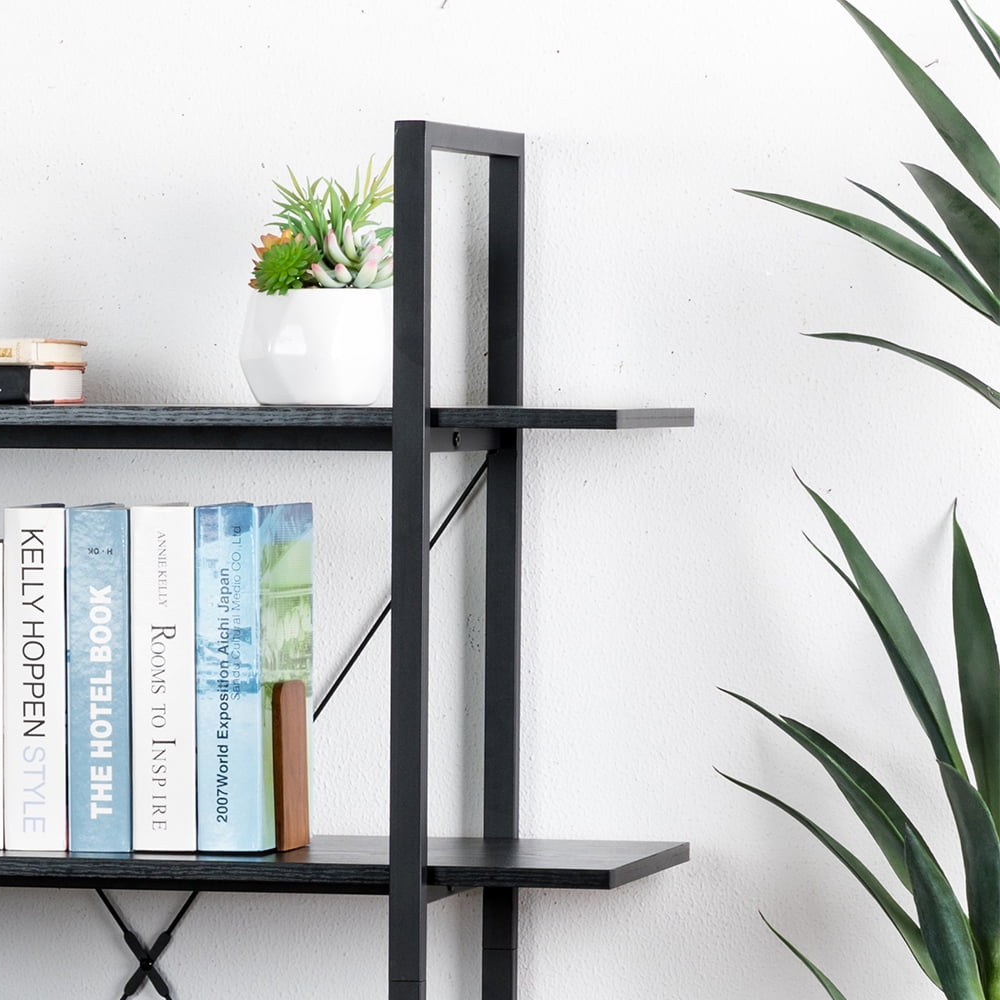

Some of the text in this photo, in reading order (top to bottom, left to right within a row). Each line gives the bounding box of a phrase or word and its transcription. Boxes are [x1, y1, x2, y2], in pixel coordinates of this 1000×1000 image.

[157, 531, 168, 608] ANNIE KELLY
[218, 567, 233, 614] Japan
[217, 617, 230, 656] Aichi
[230, 615, 241, 661] Cultural
[20, 528, 47, 834] KELLY HOPPEN STYLE
[88, 584, 113, 820] THE HOTEL BOOK
[216, 660, 232, 741] Exposition
[230, 663, 241, 701] Sandu
